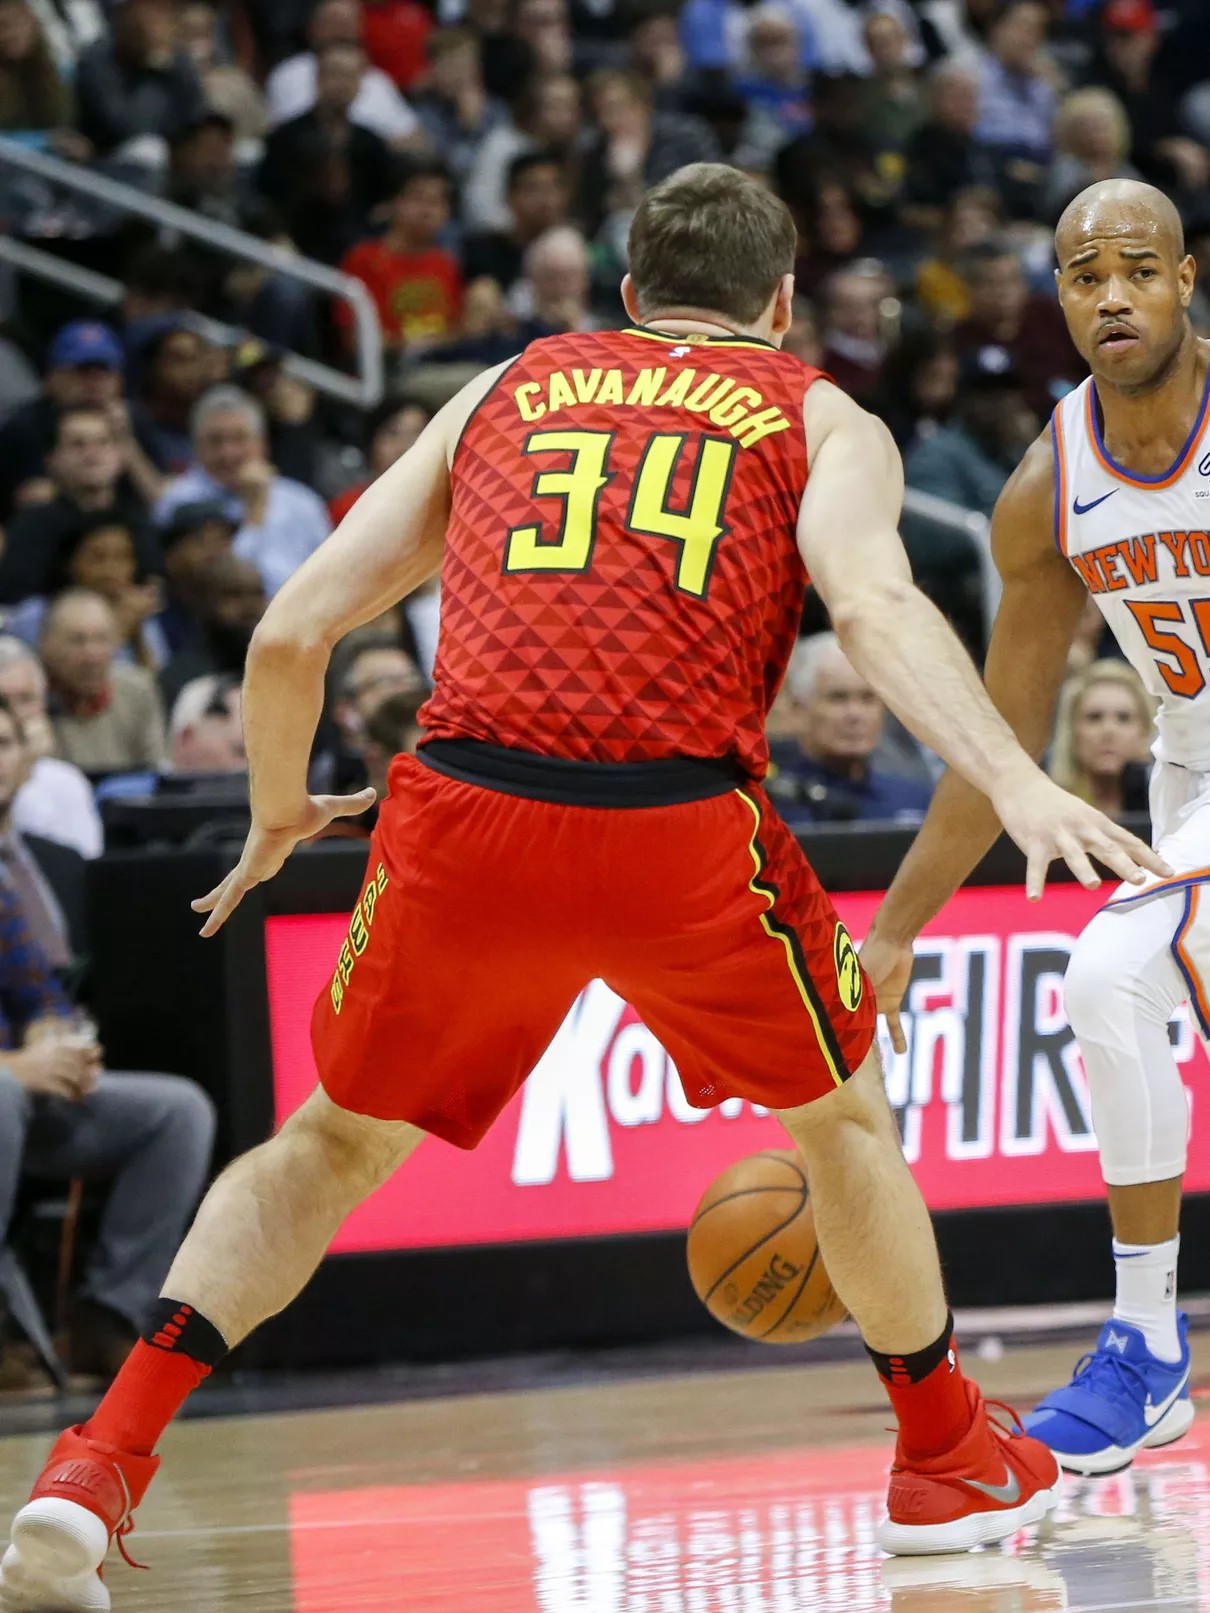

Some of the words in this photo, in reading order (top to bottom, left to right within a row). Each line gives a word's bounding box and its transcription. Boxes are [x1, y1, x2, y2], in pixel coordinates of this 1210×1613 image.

[513, 366, 792, 449] CAVANAUGH
[501, 429, 735, 602] 34
[1071, 533, 1160, 595] NEW
